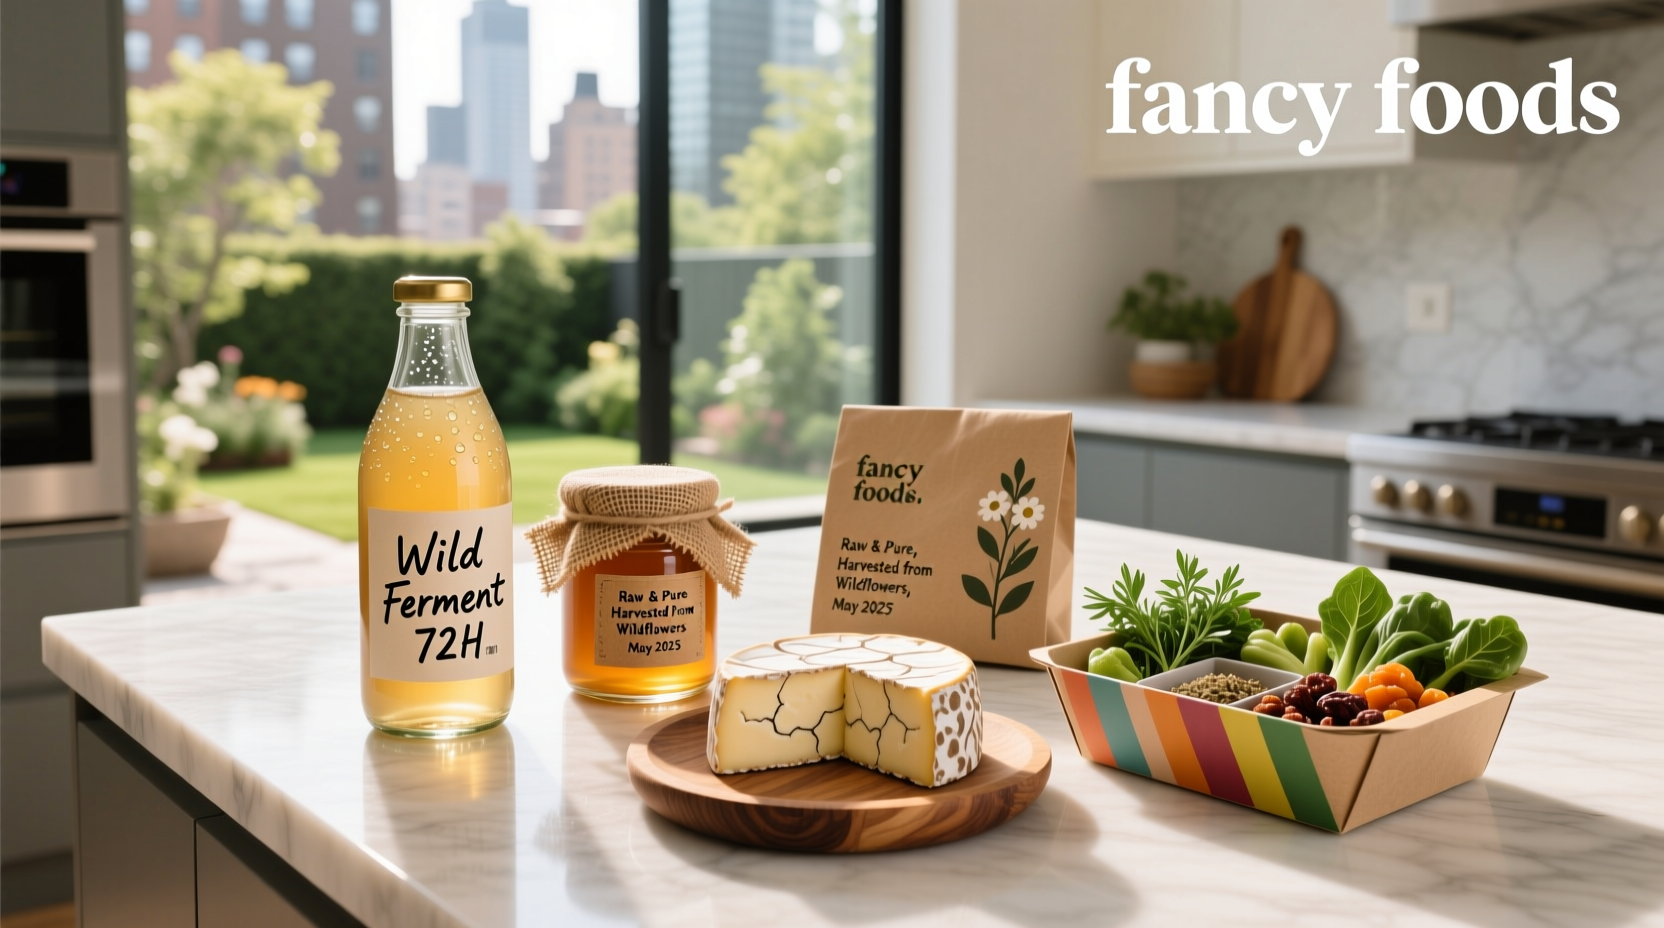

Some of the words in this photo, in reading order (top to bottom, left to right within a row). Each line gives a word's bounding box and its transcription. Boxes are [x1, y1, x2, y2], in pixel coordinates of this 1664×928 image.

[856, 454, 924, 487] fancy
[853, 479, 922, 504] foods.
[397, 526, 483, 575] Wild
[841, 537, 868, 551] Raw
[871, 540, 880, 552] &
[884, 540, 917, 558] Pure,
[837, 557, 900, 574] Harvested
[903, 561, 933, 576] from
[619, 590, 644, 602] Raw
[648, 590, 658, 602] &
[662, 590, 688, 601] Pure
[836, 576, 911, 598] Wildflowers,
[383, 572, 506, 624] Ferment
[832, 598, 859, 615] May
[861, 600, 894, 615] 2025
[611, 605, 669, 618] Harvested
[616, 622, 687, 635] Wildflowers
[415, 621, 484, 664] 72H
[628, 642, 653, 656] May
[655, 640, 681, 652] 2025
